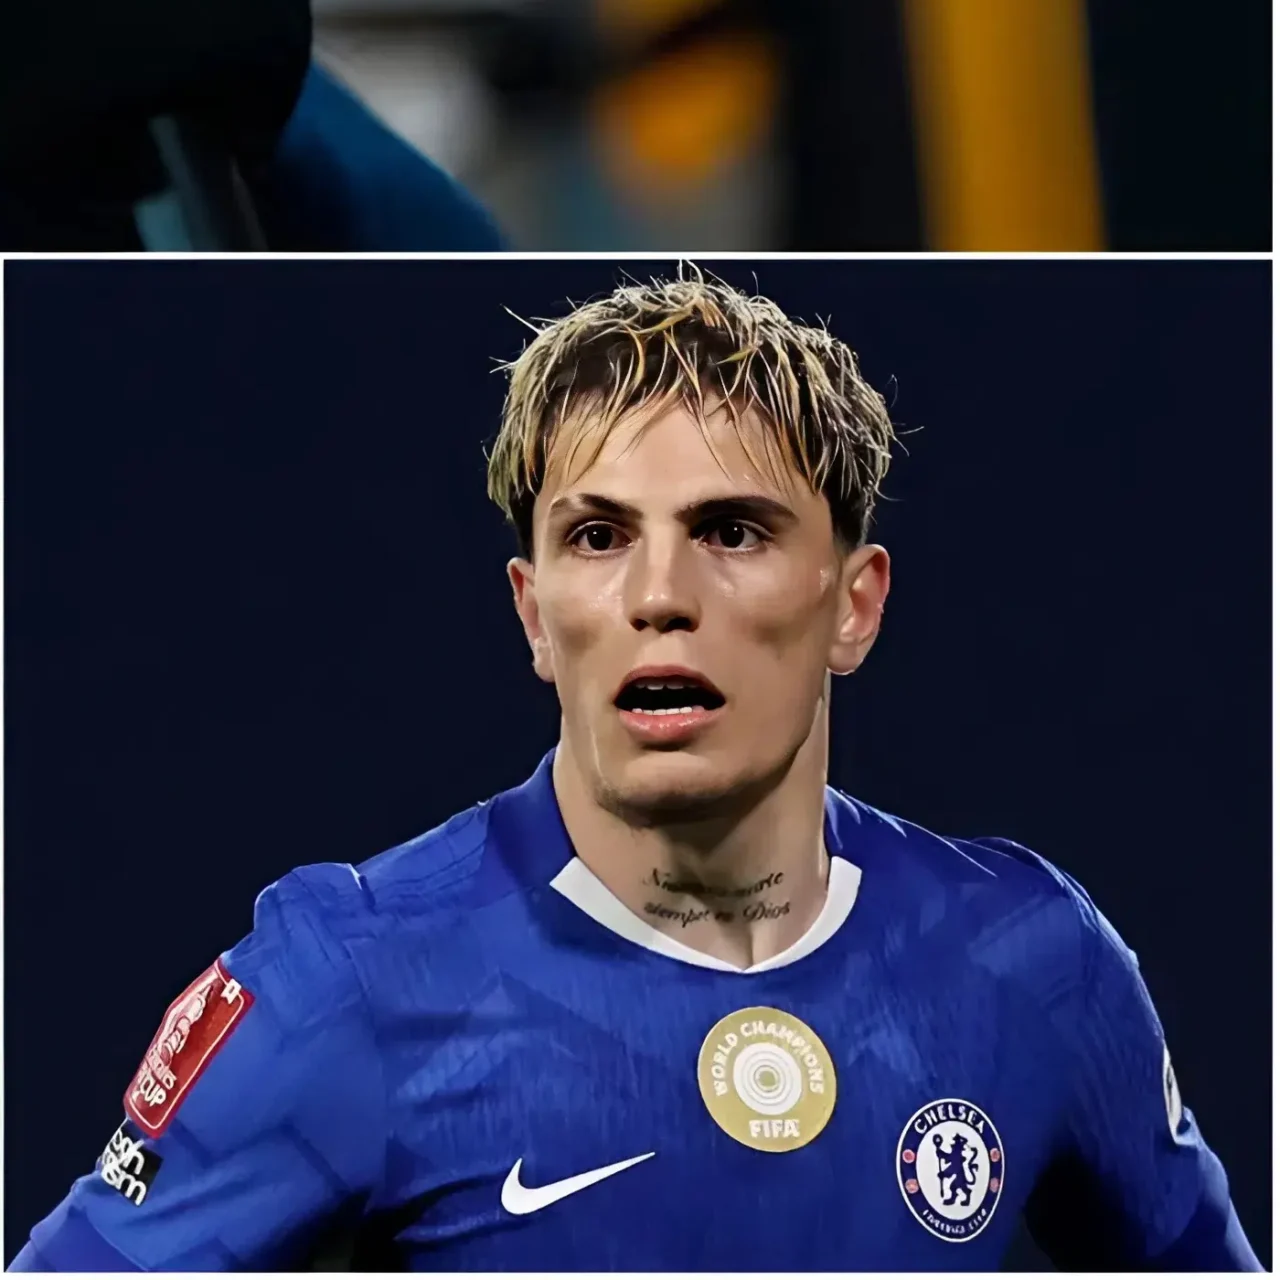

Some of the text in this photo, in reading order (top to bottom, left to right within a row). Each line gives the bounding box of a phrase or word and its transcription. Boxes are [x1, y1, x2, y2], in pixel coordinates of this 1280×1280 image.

[742, 901, 790, 921] Dios
[710, 1019, 825, 1097] WORLD CHAMPIONS
[748, 1118, 800, 1138] FIFA
[914, 1104, 985, 1135] CHELSEA
